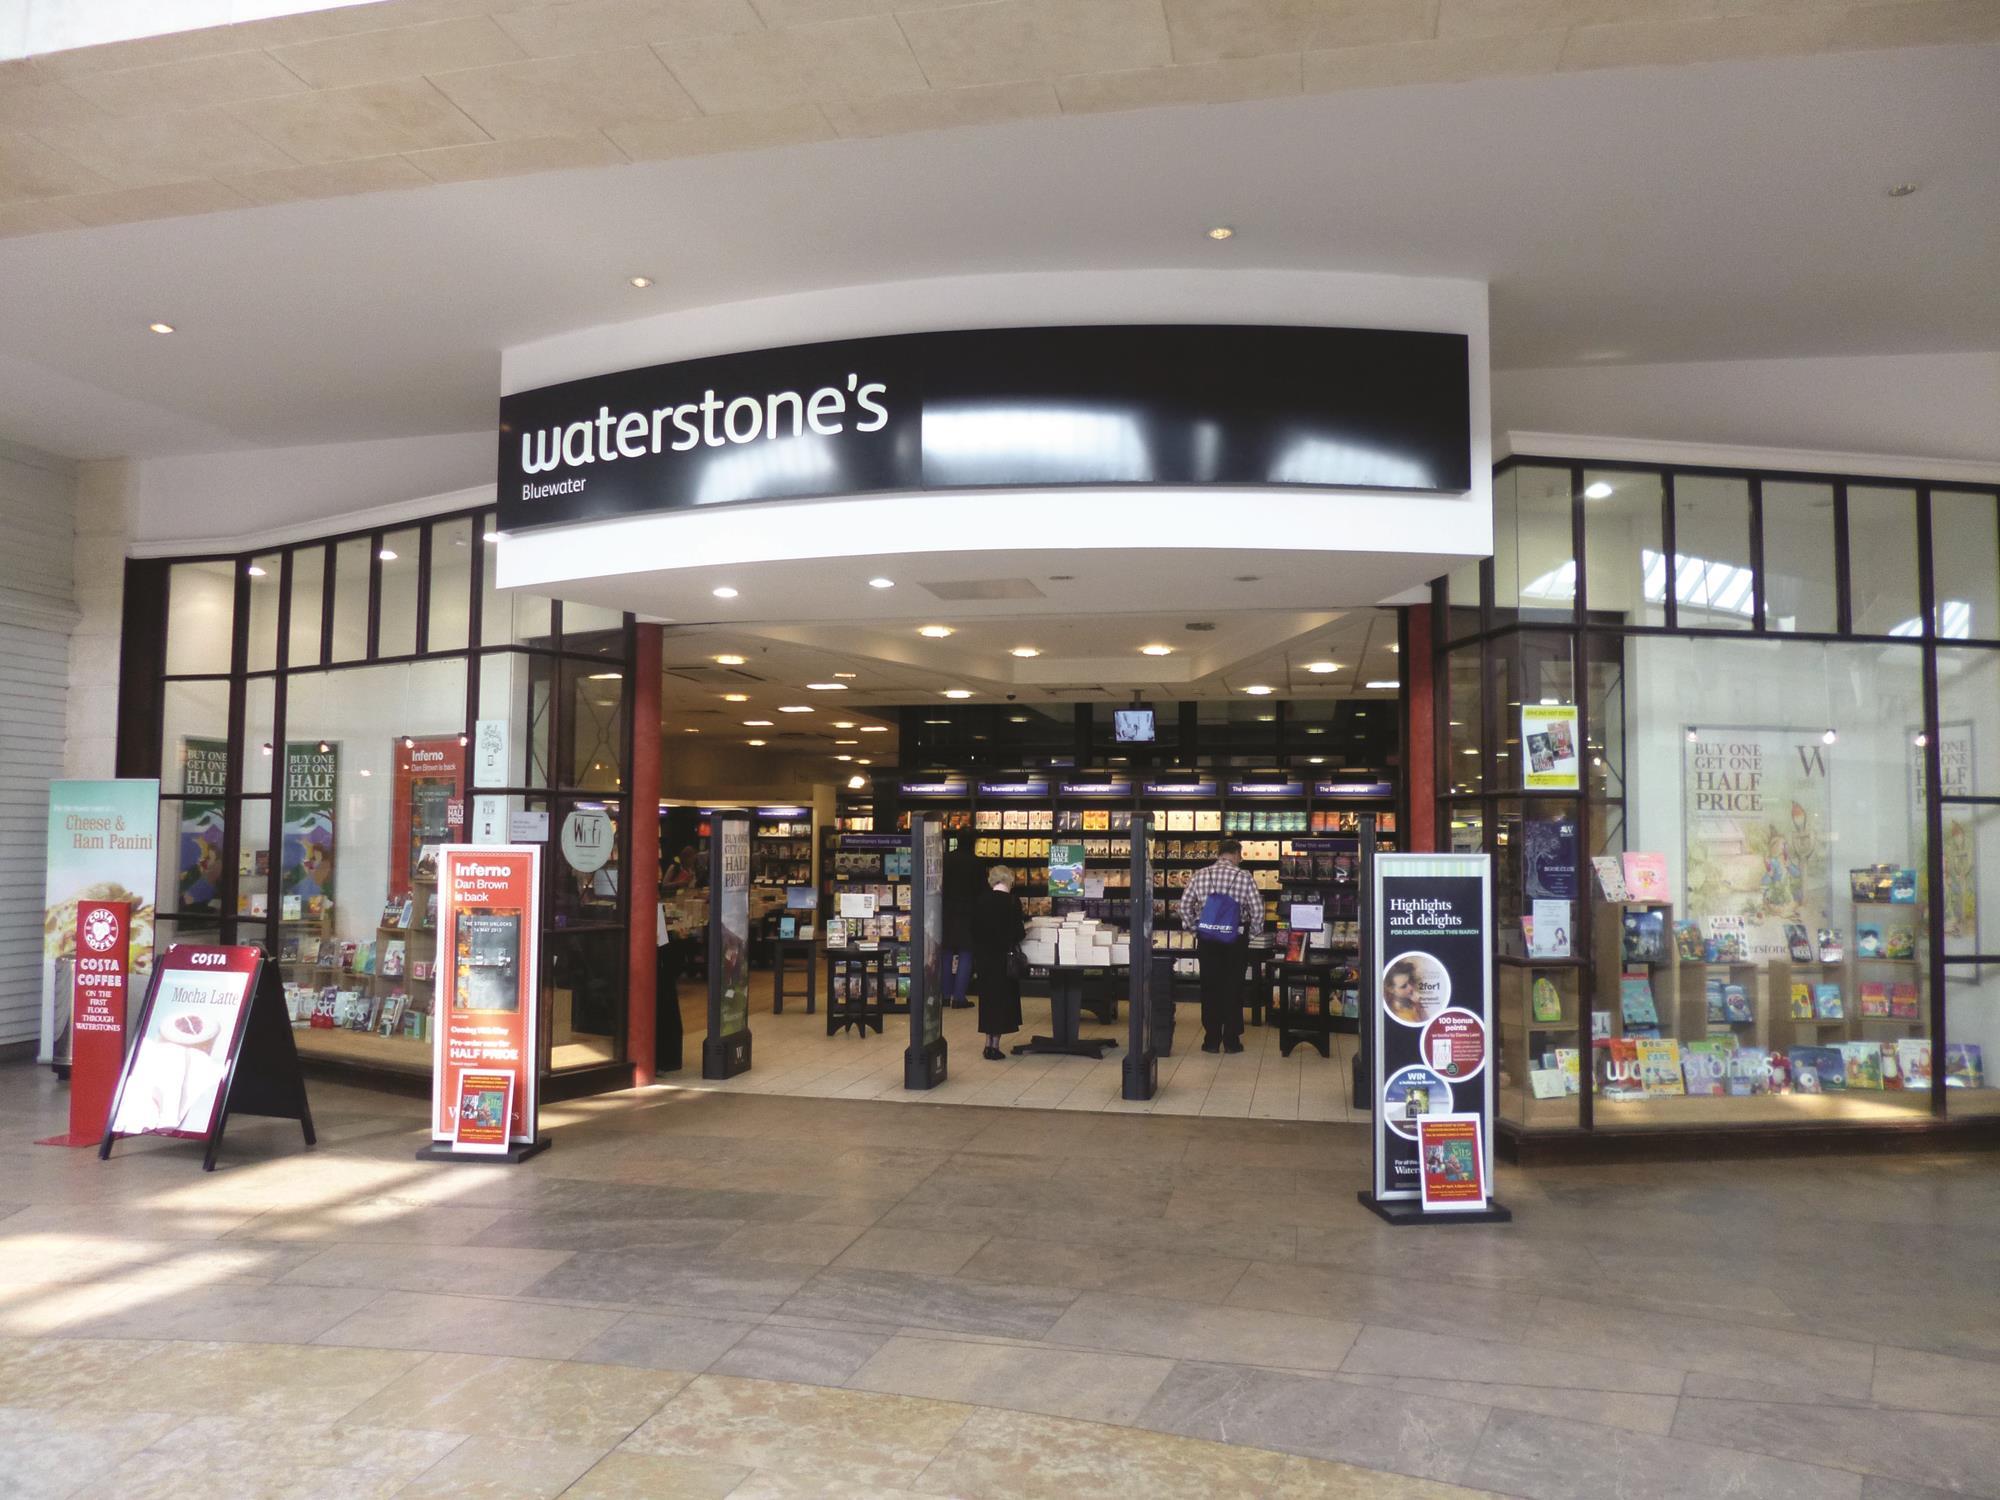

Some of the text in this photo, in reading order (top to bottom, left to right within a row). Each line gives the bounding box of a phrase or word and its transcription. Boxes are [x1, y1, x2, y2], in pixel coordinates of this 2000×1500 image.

[522, 374, 888, 474] waterstone's
[522, 476, 586, 500] Bluewater
[187, 750, 228, 762] BUY ONE
[412, 750, 444, 762] Inferno
[1695, 744, 1762, 756] BUY ONE
[187, 760, 228, 771] GET ONE
[290, 754, 335, 764] BUY ONE
[1695, 757, 1762, 770] GET ONE
[289, 764, 335, 774] GET ONE
[187, 770, 228, 786] HALF
[290, 774, 335, 788] HALF
[1695, 772, 1762, 792] HALF
[288, 788, 334, 802] PRICE
[1695, 793, 1763, 812] PRICE
[65, 814, 125, 832] Cheese &
[73, 833, 153, 850] Ham Panini
[455, 862, 511, 877] Inferno
[455, 878, 509, 889] Dan Brown
[454, 891, 489, 902] is back
[1390, 898, 1452, 914] Highlights
[88, 910, 113, 924] COSTA
[1390, 913, 1462, 929] and delights
[85, 934, 117, 950] COFFEE
[80, 959, 120, 971] COSTA
[191, 953, 227, 965] COSTA
[77, 974, 122, 987] COFFEE
[85, 990, 112, 998] ON THE
[171, 987, 239, 1006] Mocha Latte
[89, 998, 107, 1006] FIRST
[87, 1006, 109, 1014] FLOOR
[76, 1023, 121, 1031] WATERSTONES
[1445, 1025, 1468, 1033] points
[450, 1048, 481, 1059] HALF
